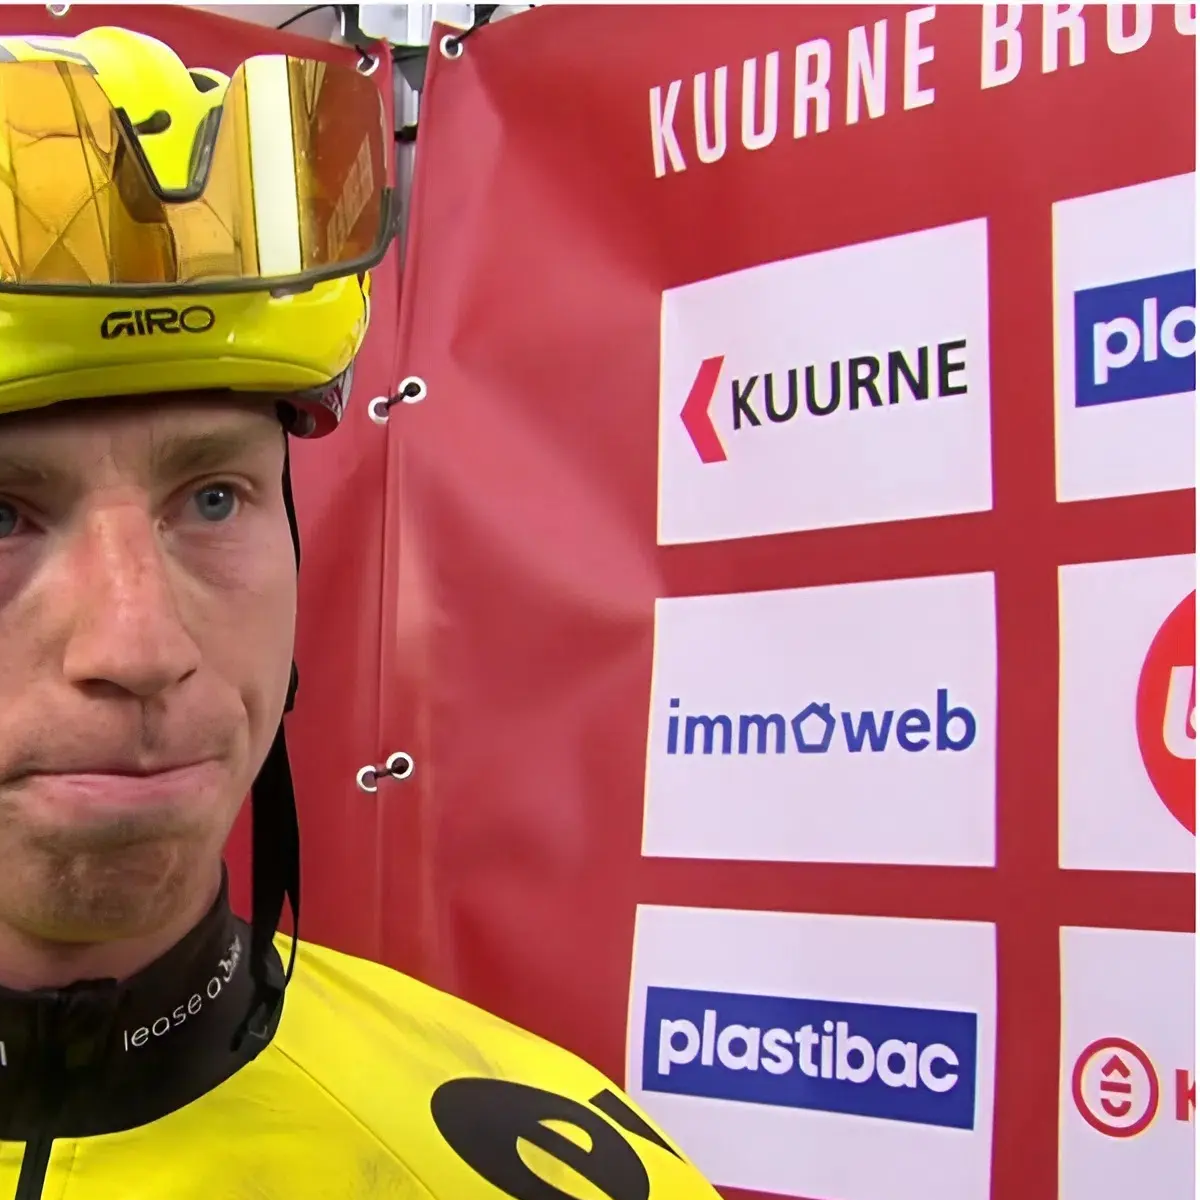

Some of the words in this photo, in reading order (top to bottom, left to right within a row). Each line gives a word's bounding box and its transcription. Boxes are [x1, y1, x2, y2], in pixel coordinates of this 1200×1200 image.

[649, 5, 936, 179] KUURNE
[100, 305, 216, 339] GIRO
[731, 338, 969, 431] KUURNE
[122, 993, 202, 1052] lease
[657, 1009, 960, 1094] plastibac
